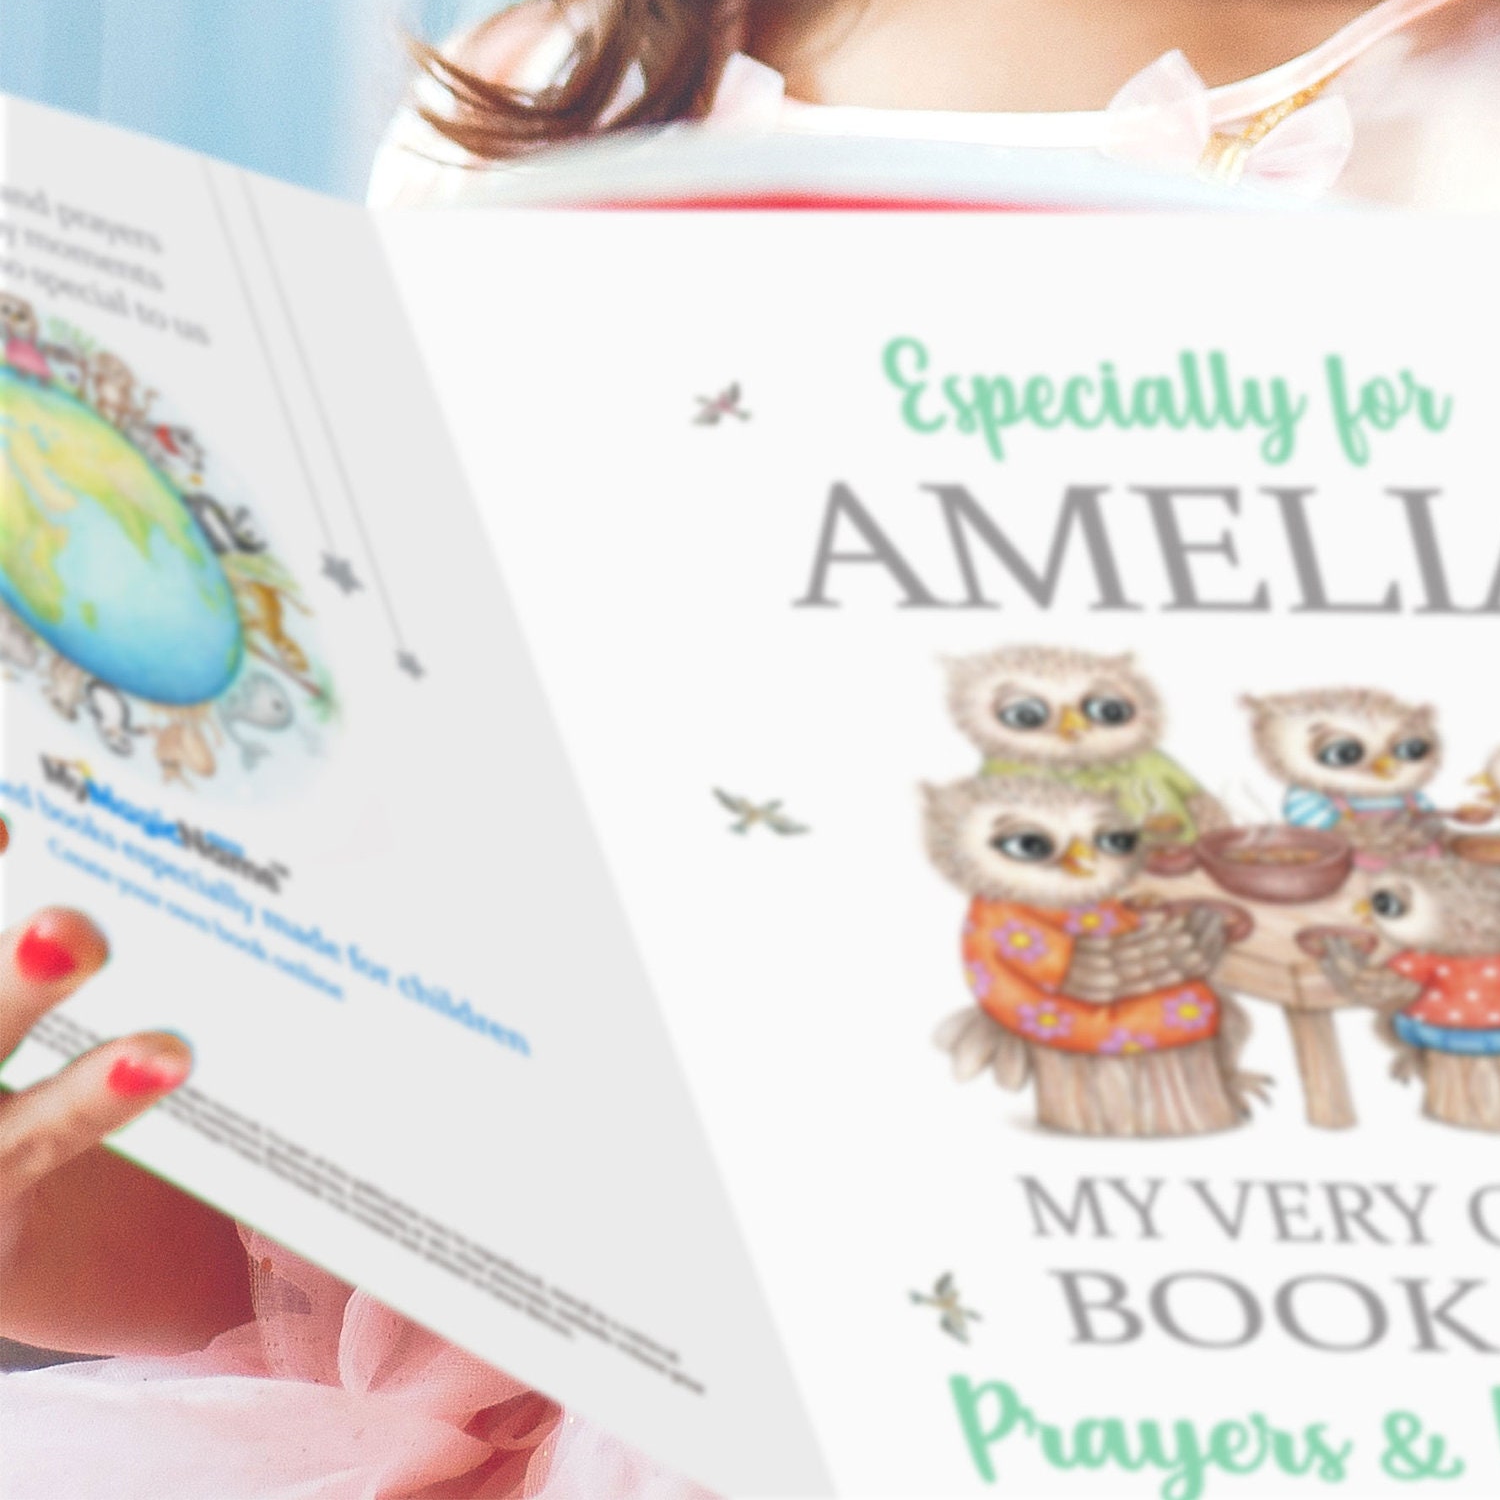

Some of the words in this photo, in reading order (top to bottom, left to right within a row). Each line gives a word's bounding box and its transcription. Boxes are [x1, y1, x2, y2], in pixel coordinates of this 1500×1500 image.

[24, 229, 164, 291] moments
[56, 202, 163, 252] prayers
[31, 266, 129, 317] special
[134, 300, 168, 332] to
[879, 335, 1309, 468] Especially
[1322, 352, 1454, 468] for
[37, 790, 117, 851] books
[122, 839, 254, 926] especially
[261, 907, 341, 962] made
[348, 943, 390, 988] for
[397, 973, 531, 1057] children
[1017, 1174, 1165, 1241] MY
[1186, 1178, 1436, 1247] VERY
[946, 1372, 1354, 1500] Prayers
[1378, 1408, 1467, 1482] &
